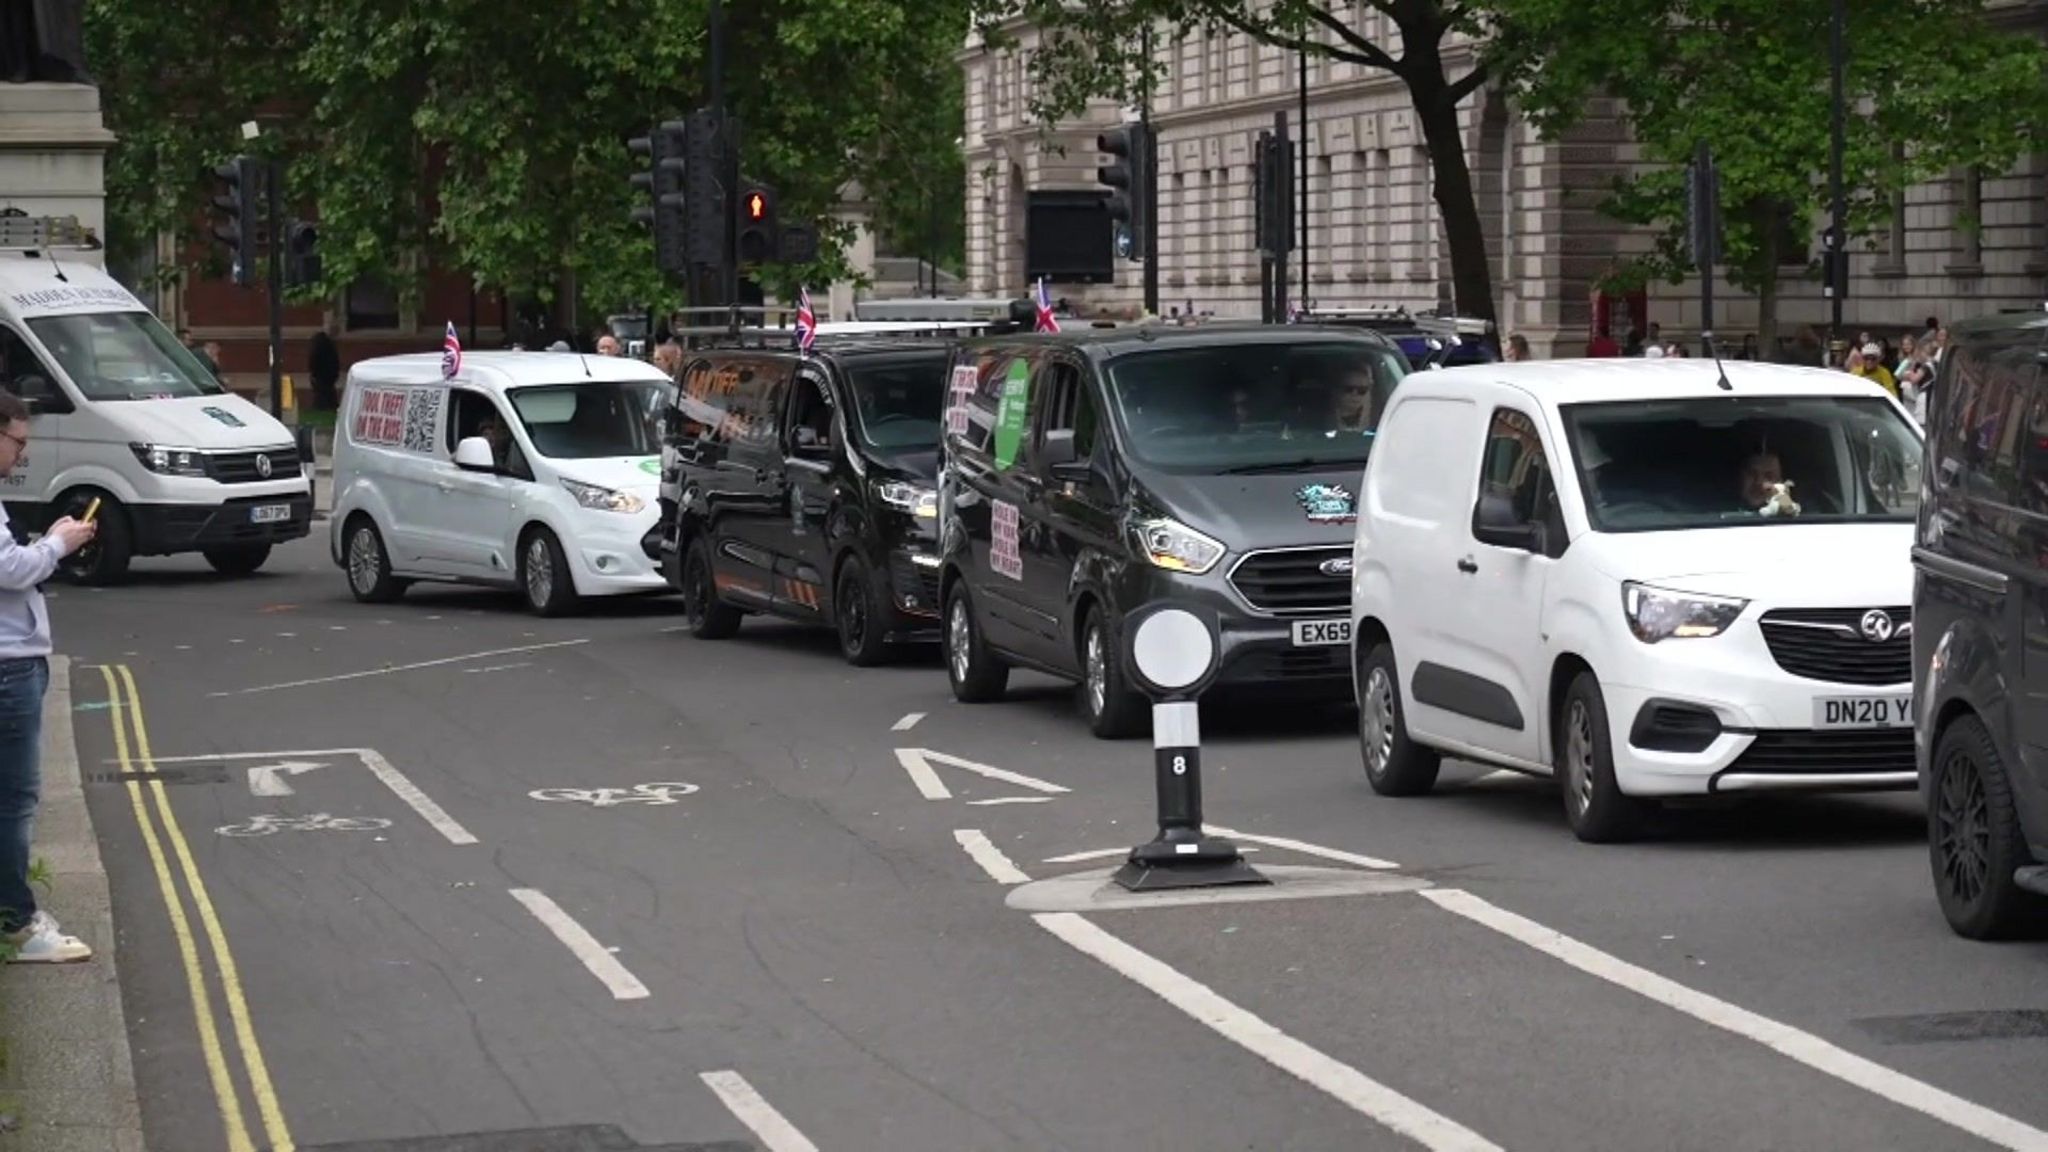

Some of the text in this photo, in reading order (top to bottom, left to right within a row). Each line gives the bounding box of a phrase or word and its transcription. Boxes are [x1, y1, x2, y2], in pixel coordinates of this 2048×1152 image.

[363, 390, 405, 416] TOOL THEFT
[356, 414, 401, 443] ON THE RISE
[1301, 621, 1351, 643] EX69
[1825, 698, 1913, 723] DN20 Y
[1173, 756, 1186, 775] 8
